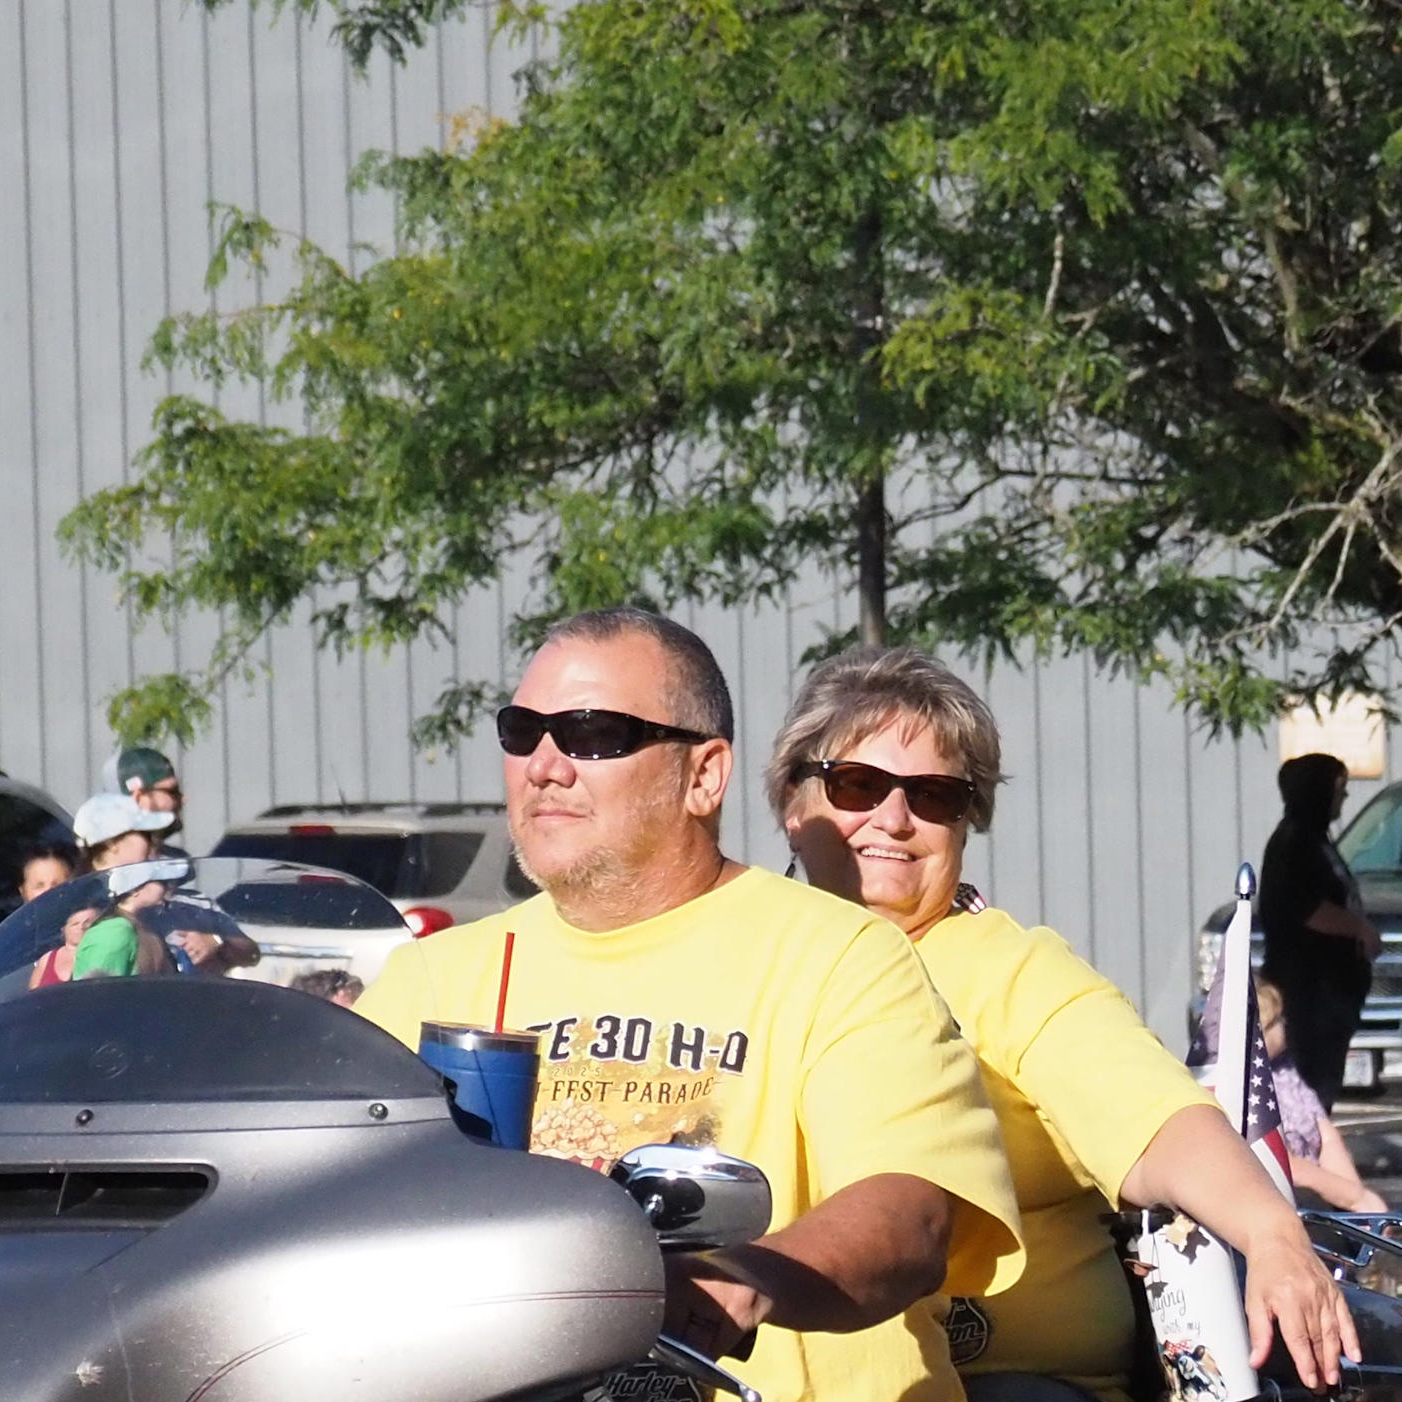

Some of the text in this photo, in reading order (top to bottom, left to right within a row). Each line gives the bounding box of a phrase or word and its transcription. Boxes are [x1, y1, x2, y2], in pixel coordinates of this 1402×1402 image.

[589, 1014, 652, 1062] 30
[551, 1080, 614, 1103] FEST
[622, 1076, 715, 1104] PARADE
